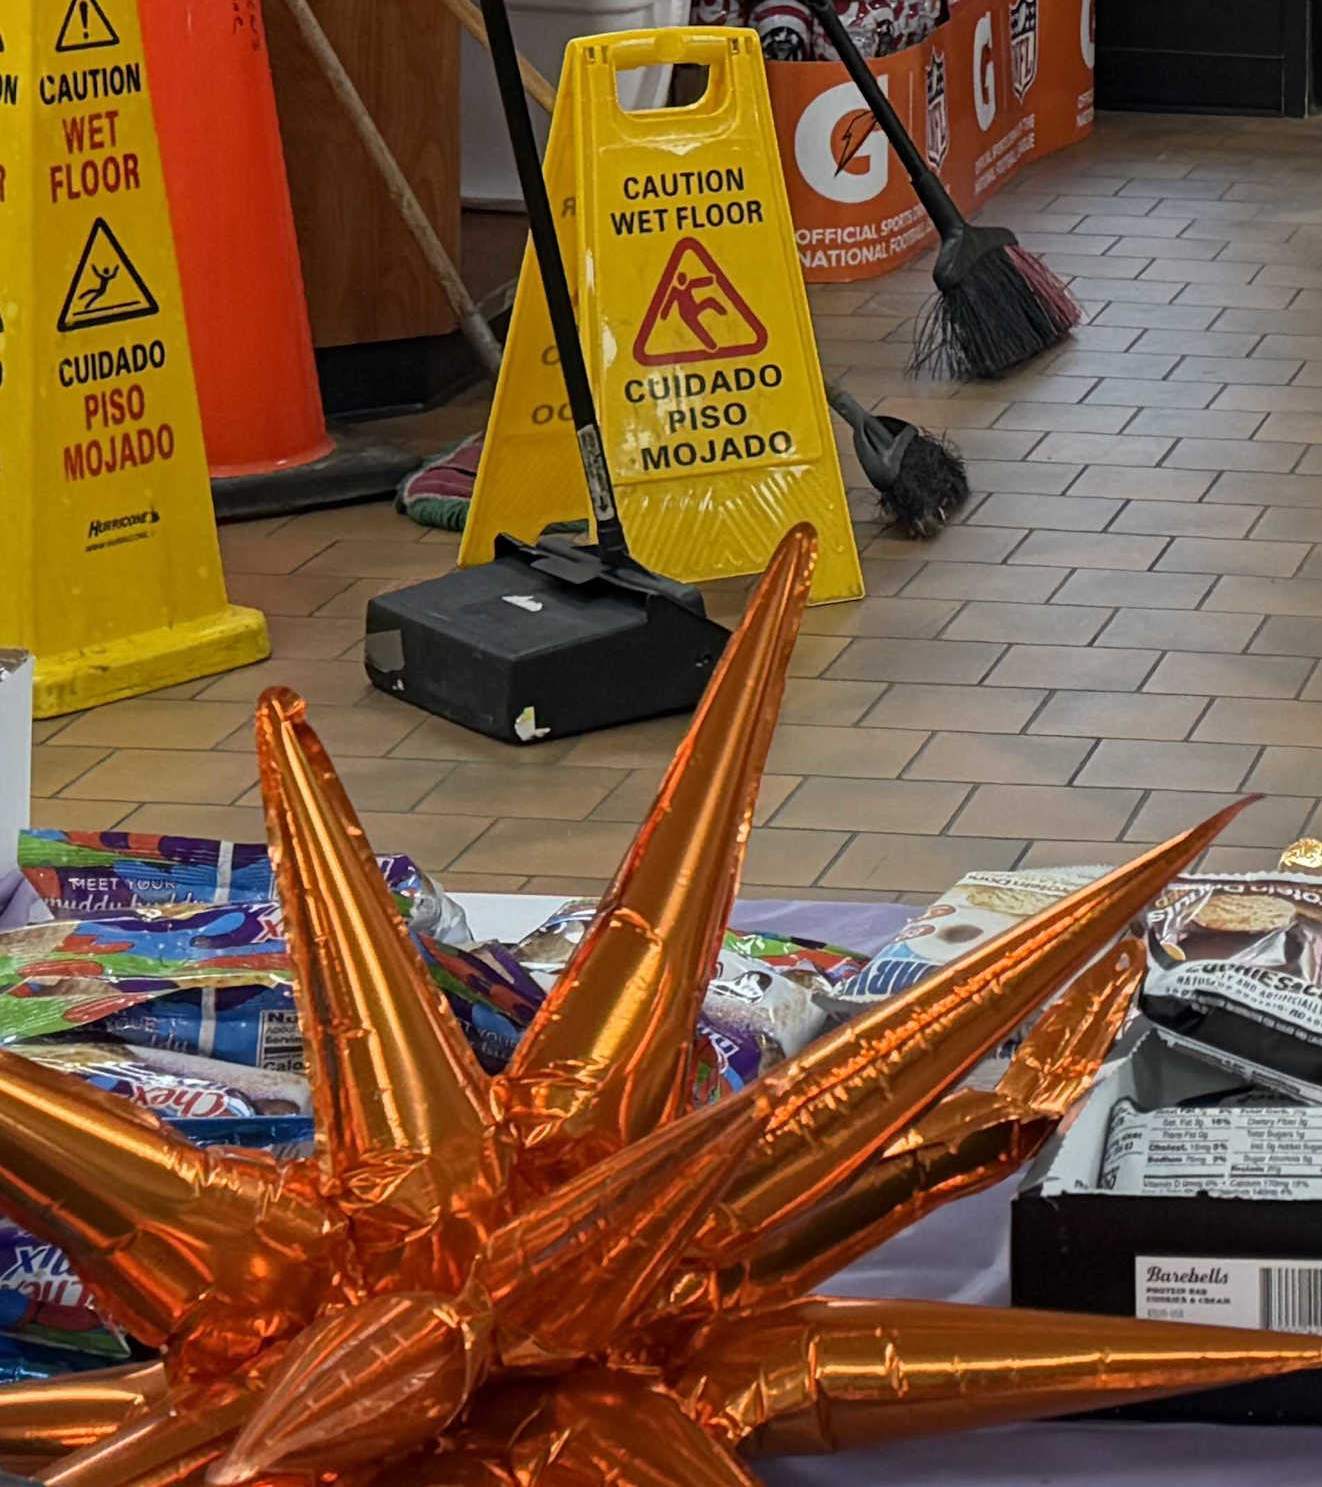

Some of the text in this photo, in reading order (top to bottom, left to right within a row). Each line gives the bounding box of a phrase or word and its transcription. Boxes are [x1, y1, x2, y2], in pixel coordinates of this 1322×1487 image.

[39, 61, 142, 107] CAUTION
[62, 109, 120, 155] WET
[50, 151, 142, 204] FLOOR
[622, 166, 746, 201] CAUTION
[610, 199, 765, 236] WET FLOOR
[796, 223, 878, 247] OFFICIAL
[797, 243, 889, 270] NATIONAL
[58, 338, 167, 389] CUIDADO
[624, 363, 784, 404] CUIDADO
[84, 383, 146, 432] PISO
[668, 401, 748, 435] PISO
[63, 422, 176, 484] MOJADO
[640, 429, 793, 472] MOJADO
[68, 876, 177, 892] MEET YOUR
[1145, 1265, 1230, 1286] Barebells
